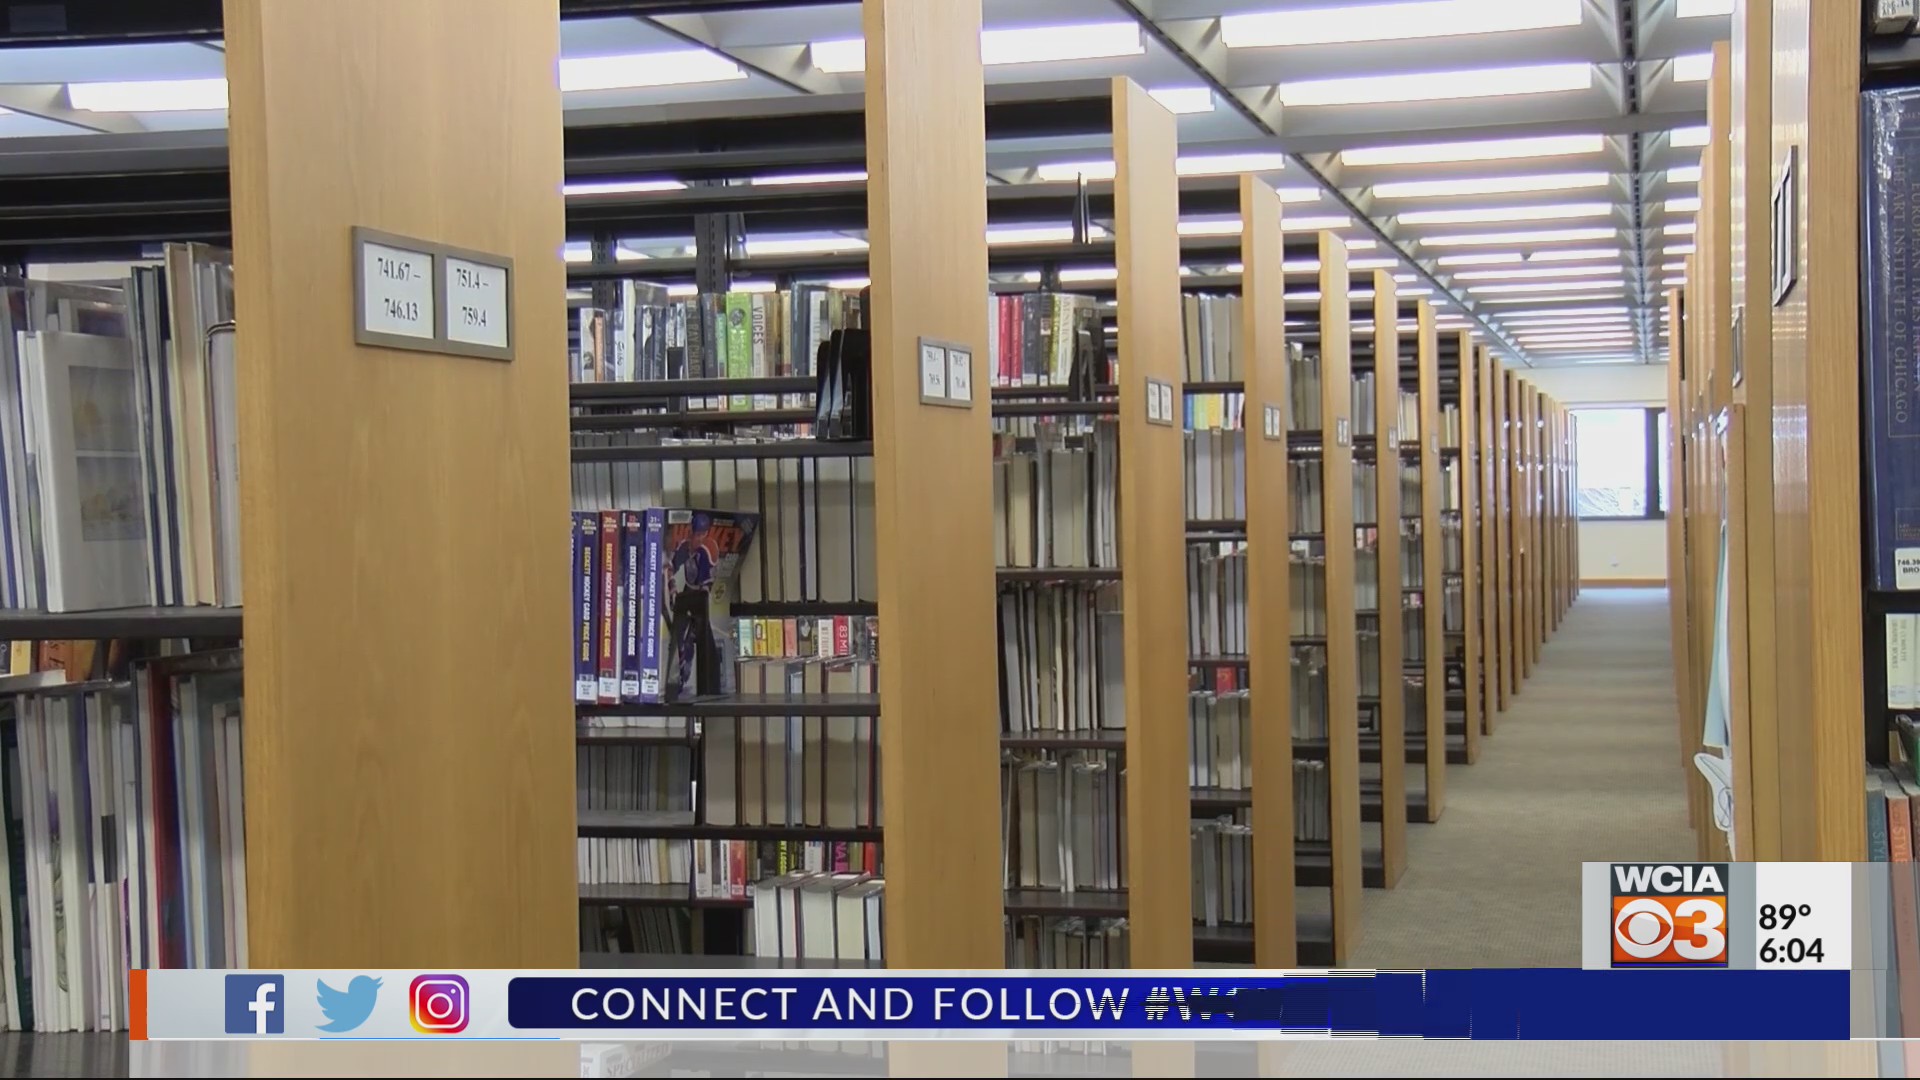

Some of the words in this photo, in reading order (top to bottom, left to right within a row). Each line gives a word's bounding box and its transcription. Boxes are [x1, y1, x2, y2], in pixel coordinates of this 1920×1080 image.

[1894, 192, 1906, 223] ART
[377, 257, 410, 281] 741.67
[456, 268, 480, 289] 751.4
[1894, 228, 1906, 316] INSTITUTE
[384, 298, 418, 321] 746.13
[462, 306, 487, 327] 759.4
[752, 306, 764, 345] VOICES
[1895, 320, 1907, 341] OF
[1895, 346, 1908, 424] CHICAGO
[839, 625, 848, 638] 83
